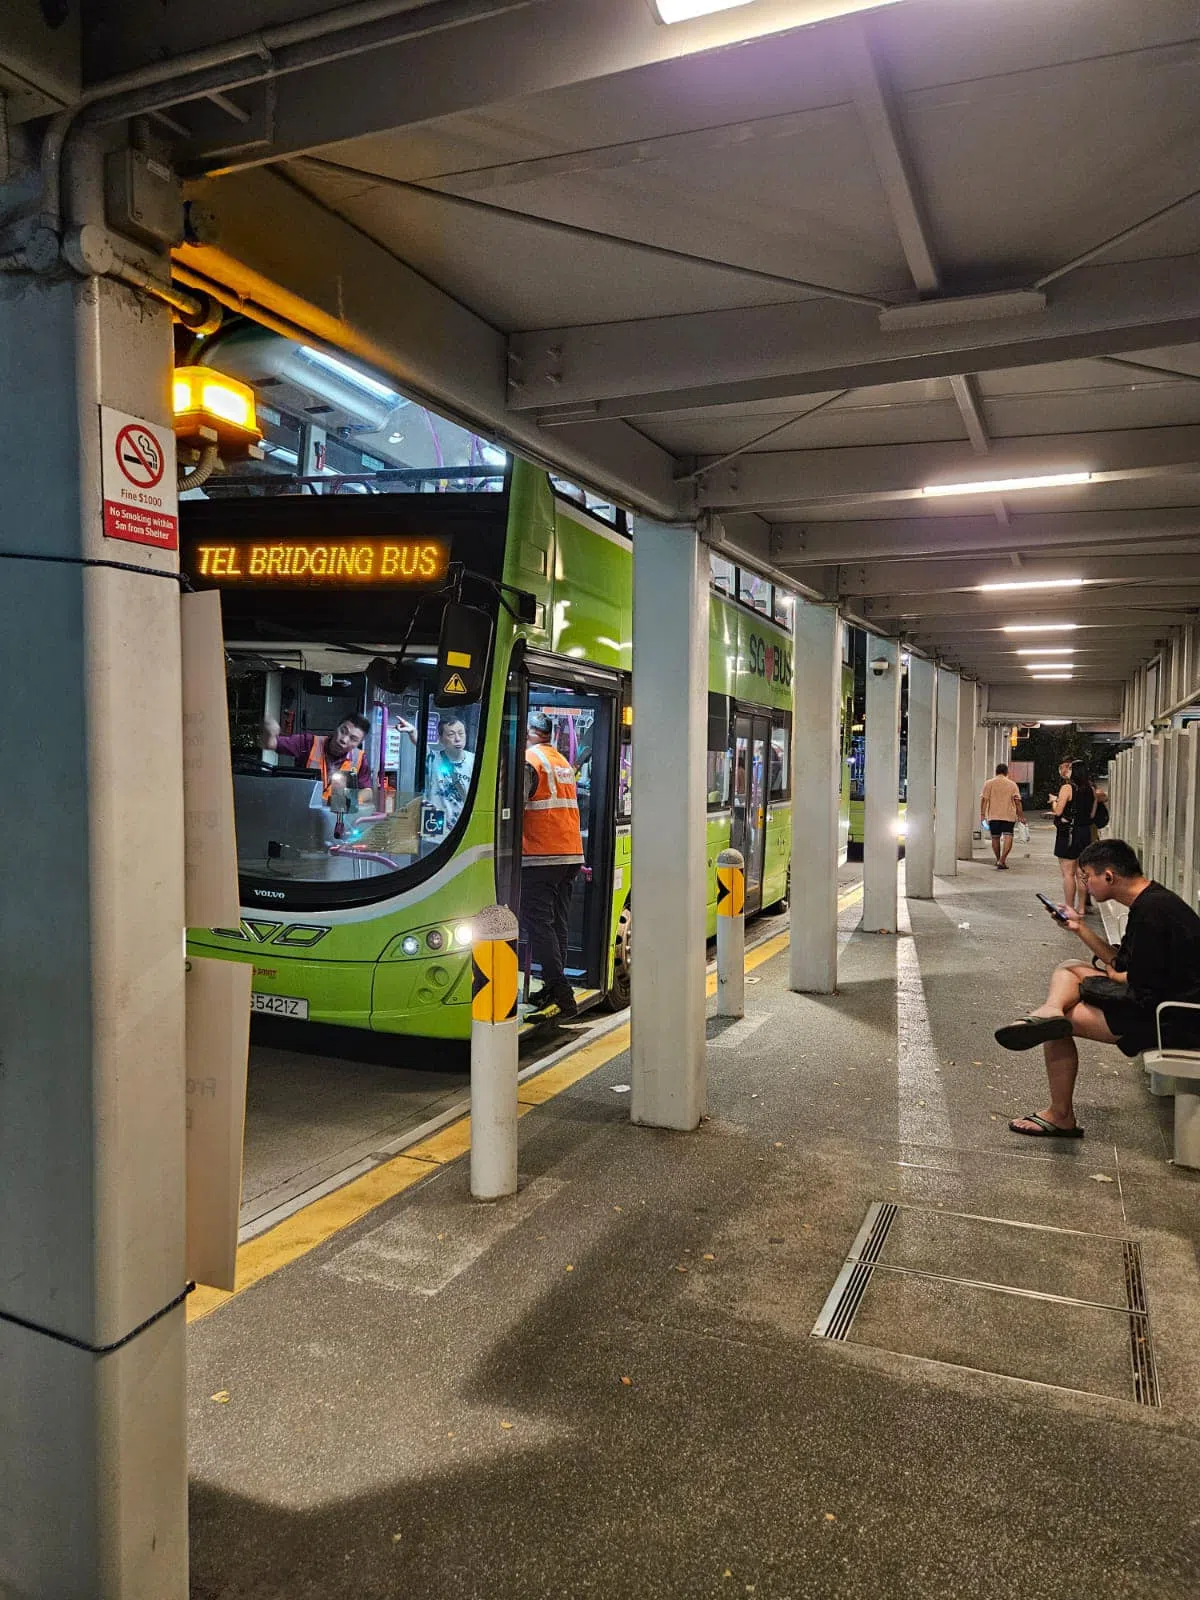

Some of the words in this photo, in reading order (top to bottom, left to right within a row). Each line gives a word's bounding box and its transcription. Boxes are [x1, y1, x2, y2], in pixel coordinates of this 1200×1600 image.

[121, 488, 137, 502] Fine
[139, 493, 162, 507] $1000
[110, 506, 121, 517] No
[121, 509, 152, 526] Smoking
[152, 517, 174, 530] within
[115, 520, 127, 531] 5m
[128, 522, 144, 535] from
[145, 526, 170, 540] Shelter
[198, 547, 241, 575] TEL
[249, 546, 375, 576] BRIDGING
[380, 545, 439, 575] BUS
[253, 889, 286, 899] VOLVO
